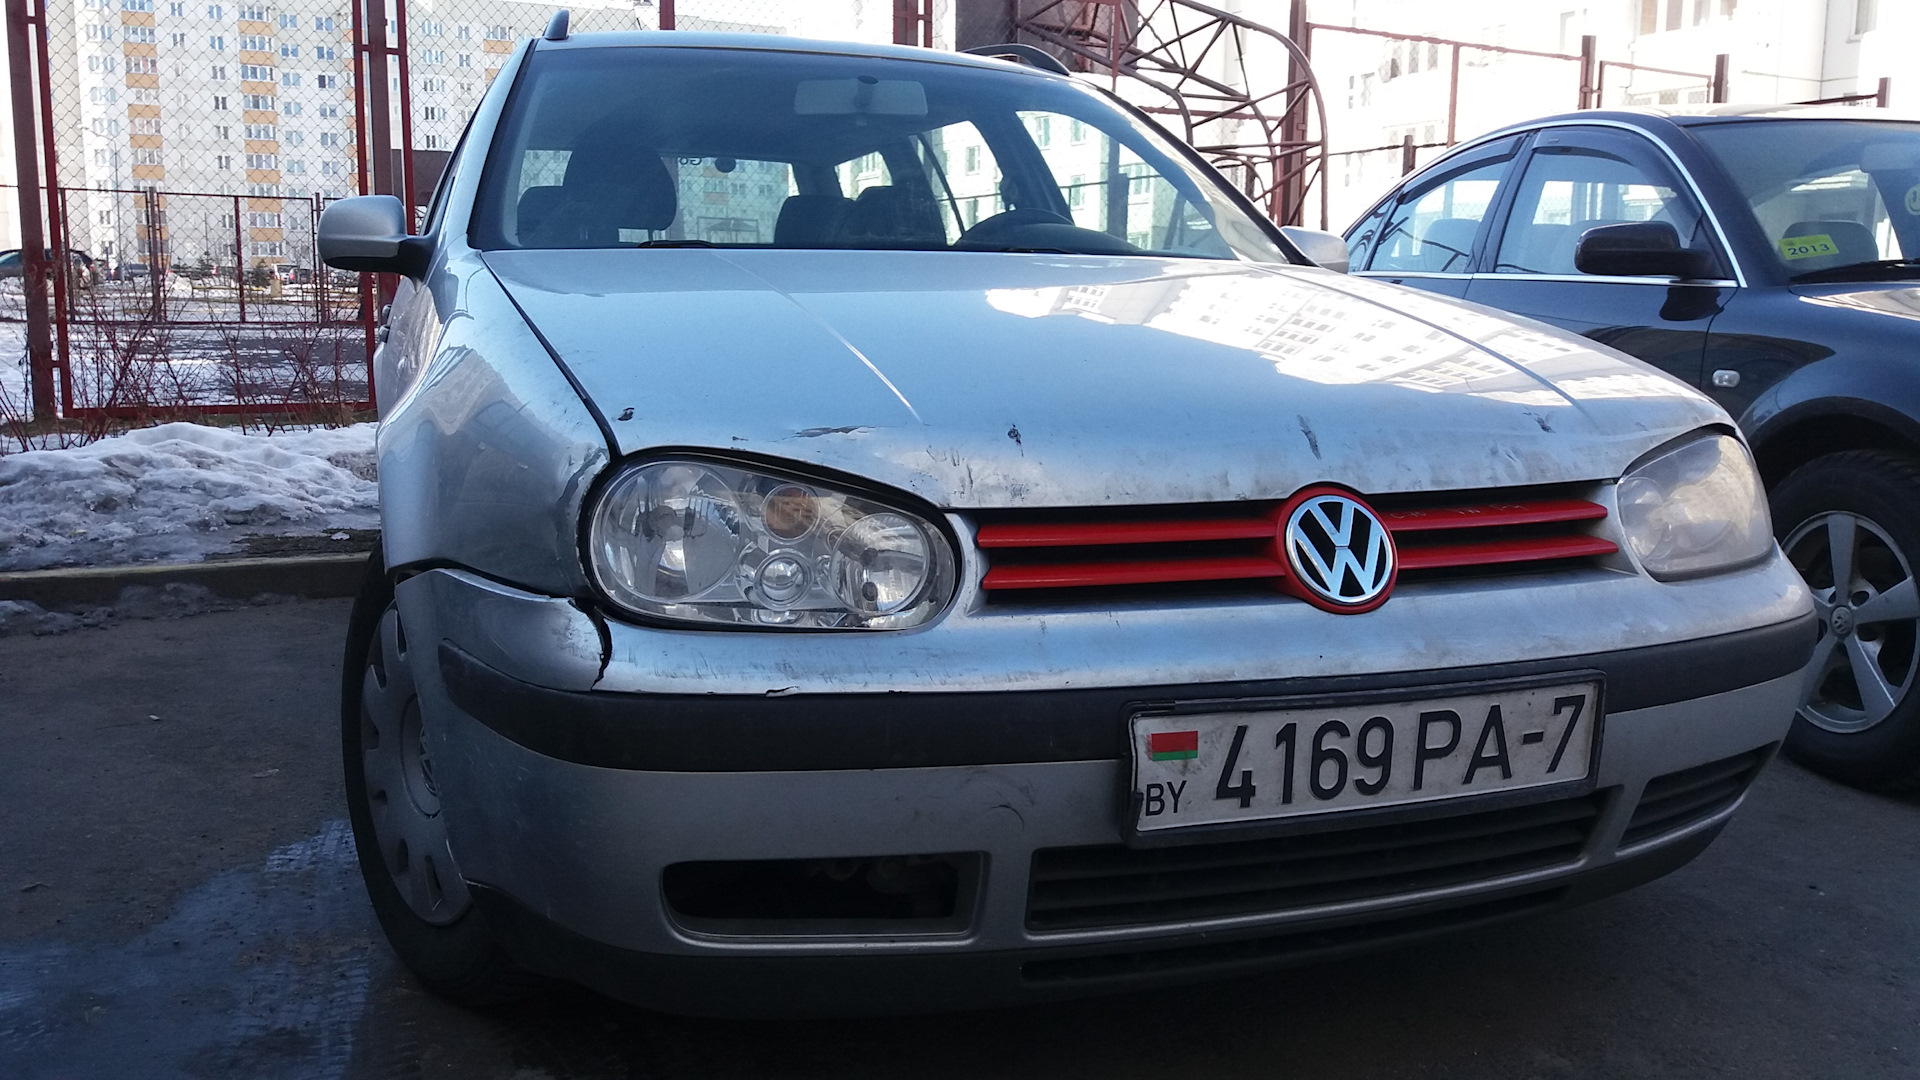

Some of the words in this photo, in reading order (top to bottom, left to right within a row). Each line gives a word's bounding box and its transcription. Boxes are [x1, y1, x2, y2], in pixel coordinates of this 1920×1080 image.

[1788, 243, 1829, 255] 2013
[1215, 716, 1394, 809] 4169
[1144, 780, 1187, 817] BY
